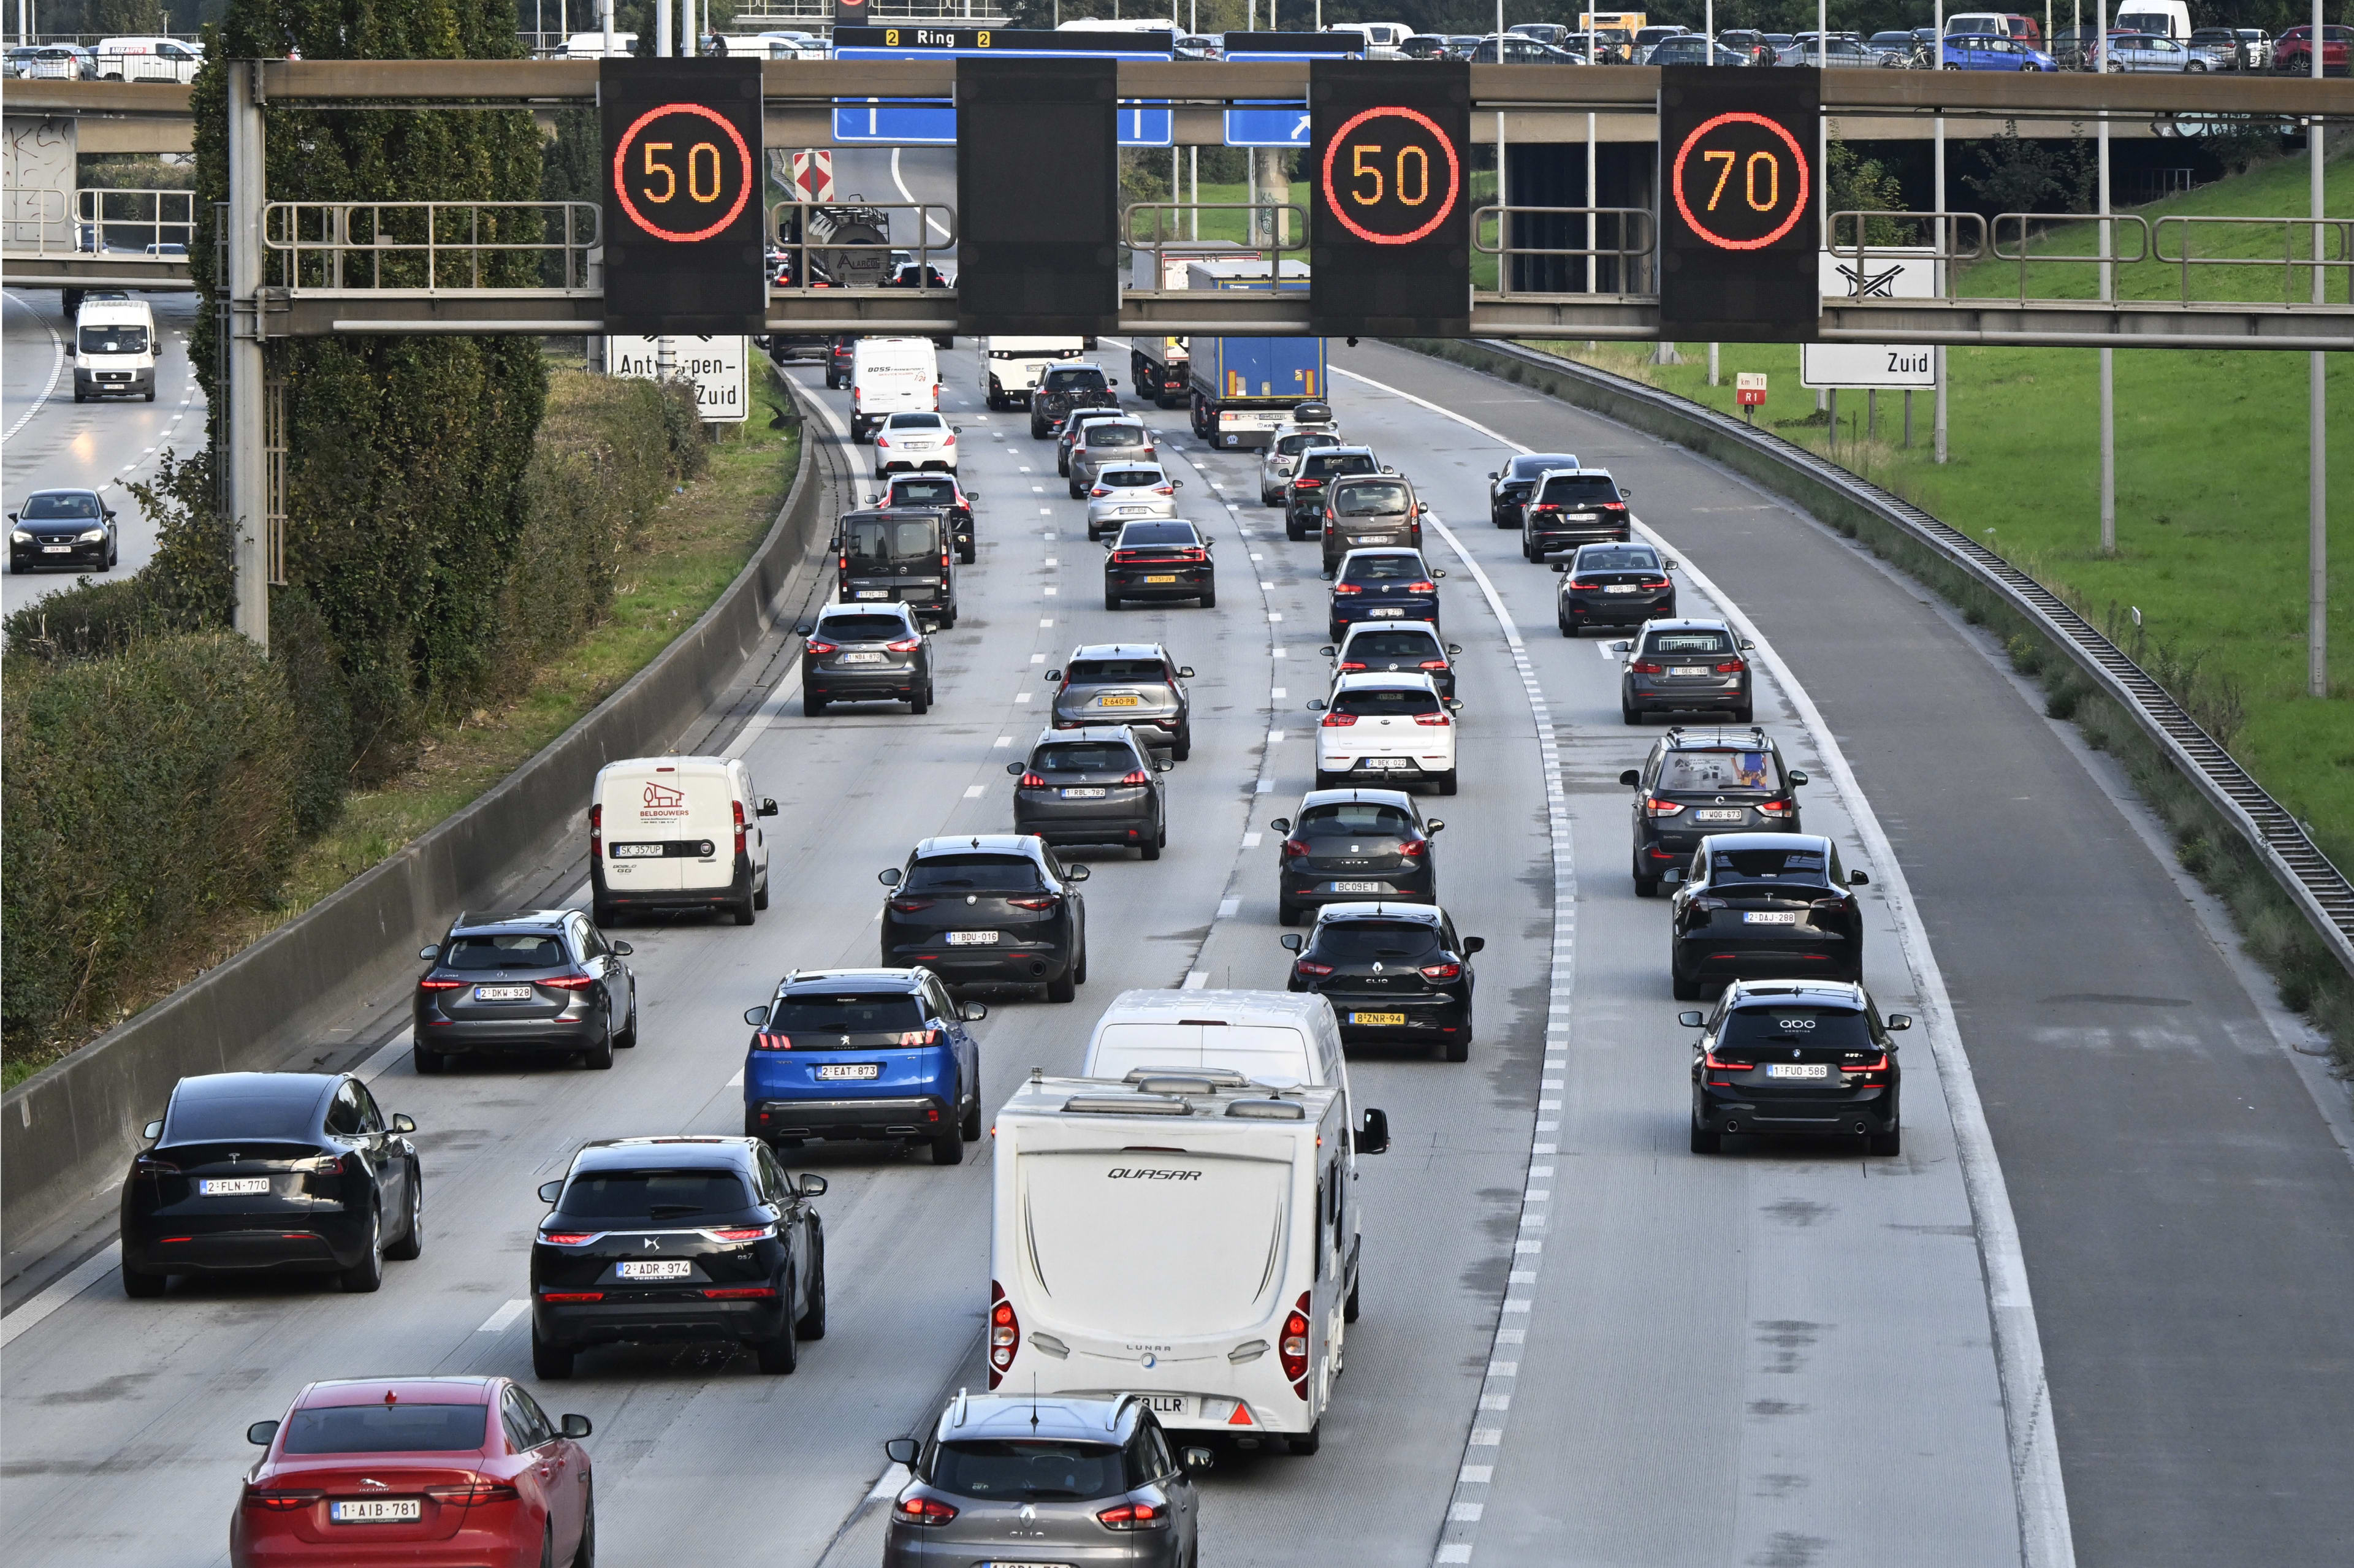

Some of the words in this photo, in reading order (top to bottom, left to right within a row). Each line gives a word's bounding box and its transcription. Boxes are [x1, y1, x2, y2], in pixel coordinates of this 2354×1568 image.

[888, 31, 896, 44] 2
[918, 30, 954, 48] Ring
[980, 33, 988, 46] 2
[644, 143, 721, 203] 50
[1352, 145, 1428, 206] 50
[1704, 151, 1778, 211] 70
[1887, 352, 1927, 372] Zuid
[696, 386, 736, 405] Zuid
[621, 846, 631, 854] SK
[635, 845, 661, 854] 357UP
[1749, 913, 1794, 922] 2-DAJ-288
[481, 987, 530, 998] 2-DKW-928
[1357, 1013, 1401, 1022] 8-ZNR-94
[1780, 1019, 1816, 1029] abc
[822, 1066, 875, 1075] 2-EAT-873
[1107, 1168, 1202, 1181] QUASAR
[208, 1181, 267, 1192] 2-FLN-770
[624, 1262, 688, 1275] 2-ADR-974
[342, 1503, 417, 1517] 1-AIB-781
